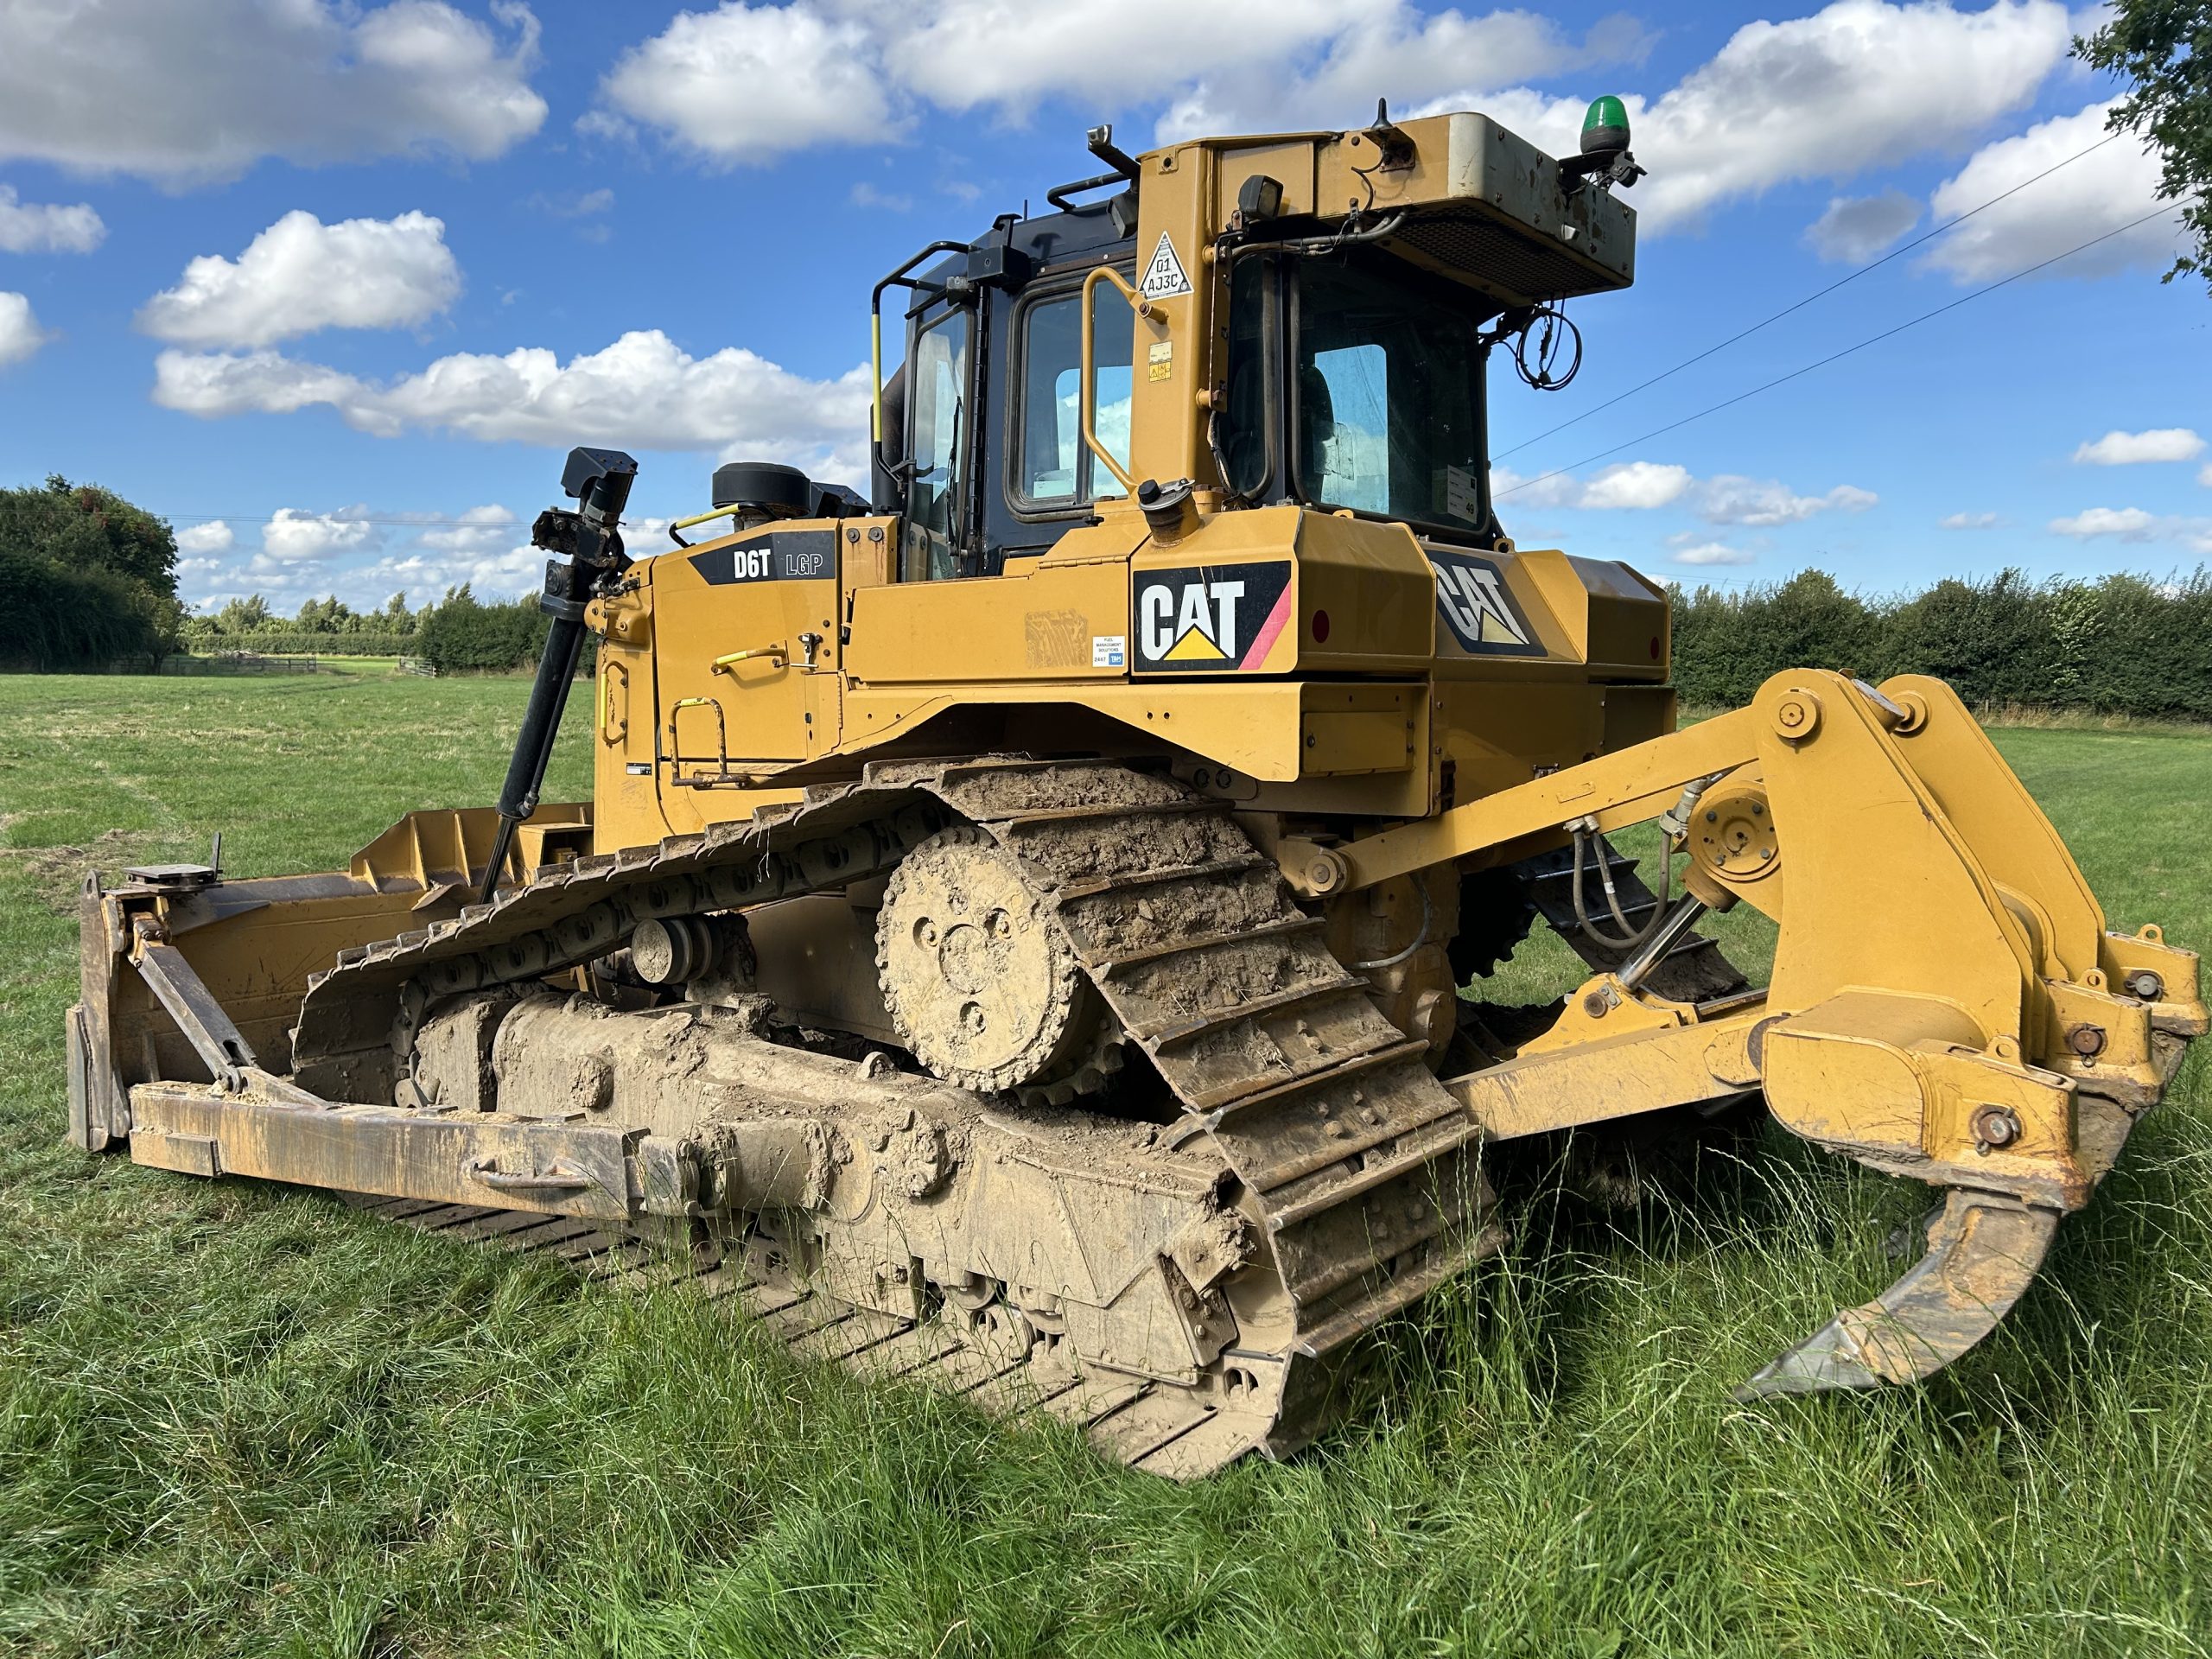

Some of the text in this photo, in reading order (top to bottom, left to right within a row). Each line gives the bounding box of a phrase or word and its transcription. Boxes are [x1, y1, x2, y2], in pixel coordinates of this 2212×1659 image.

[1147, 273, 1178, 292] AJ3C
[1465, 502, 1474, 515] 49
[734, 549, 823, 578] D6T LGP
[1430, 560, 1530, 645] CAT
[1141, 581, 1245, 661] CAT
